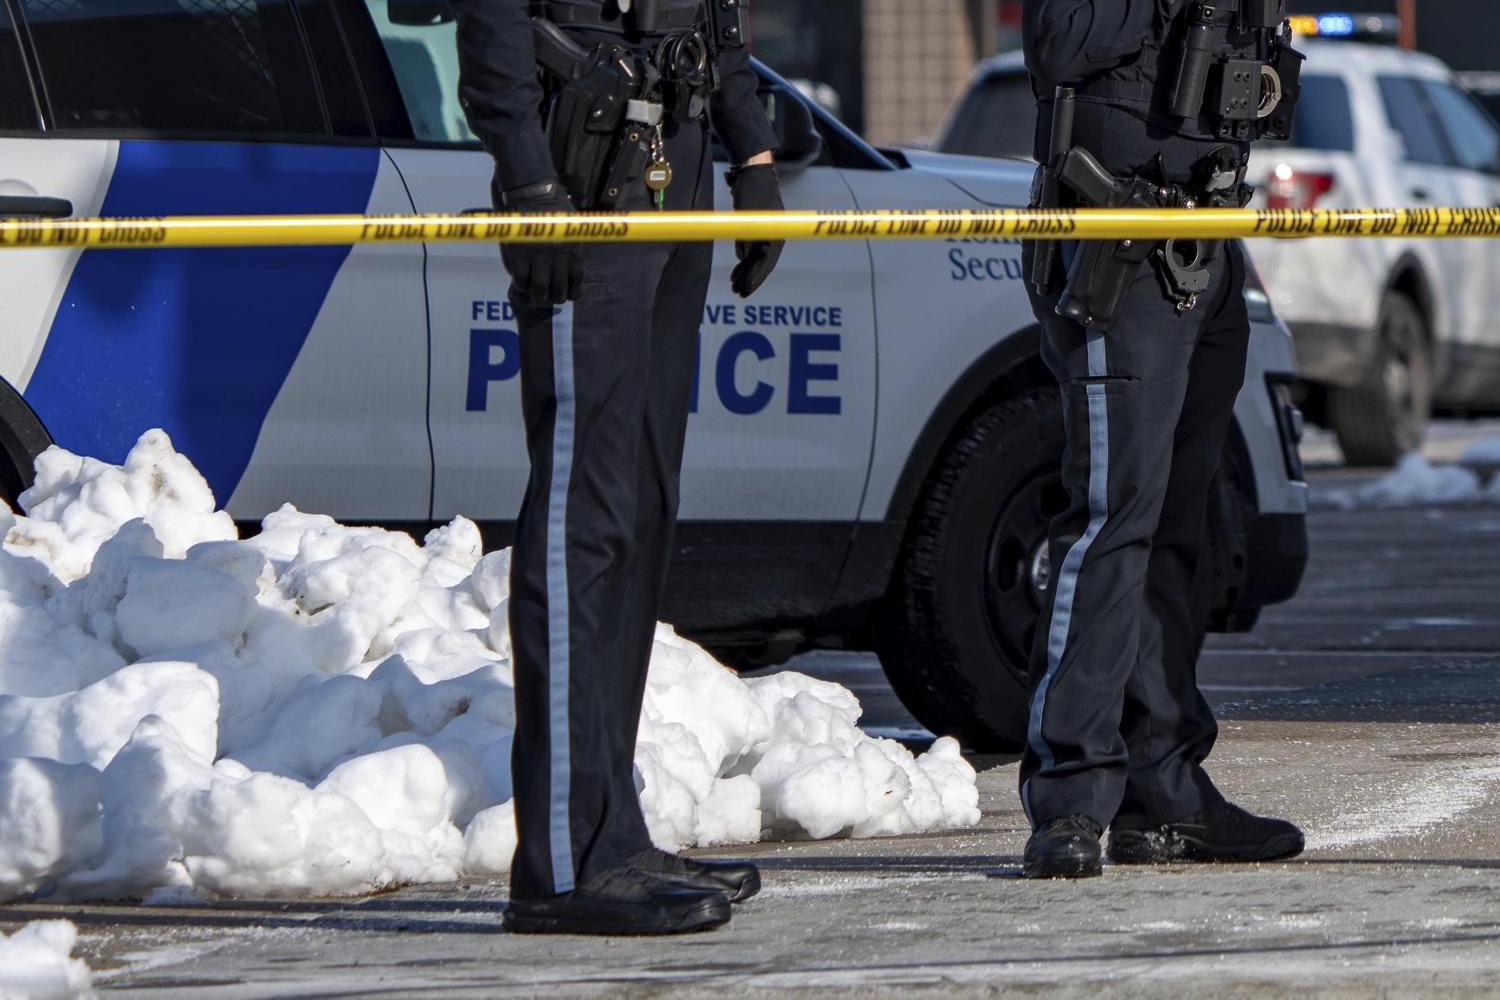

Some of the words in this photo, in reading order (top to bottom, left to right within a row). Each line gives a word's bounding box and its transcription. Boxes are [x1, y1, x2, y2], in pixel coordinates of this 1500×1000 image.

[1254, 208, 1317, 233] POLICE
[1325, 208, 1367, 233] LINE
[948, 247, 1022, 280] Secu
[743, 305, 842, 326] SERVICE
